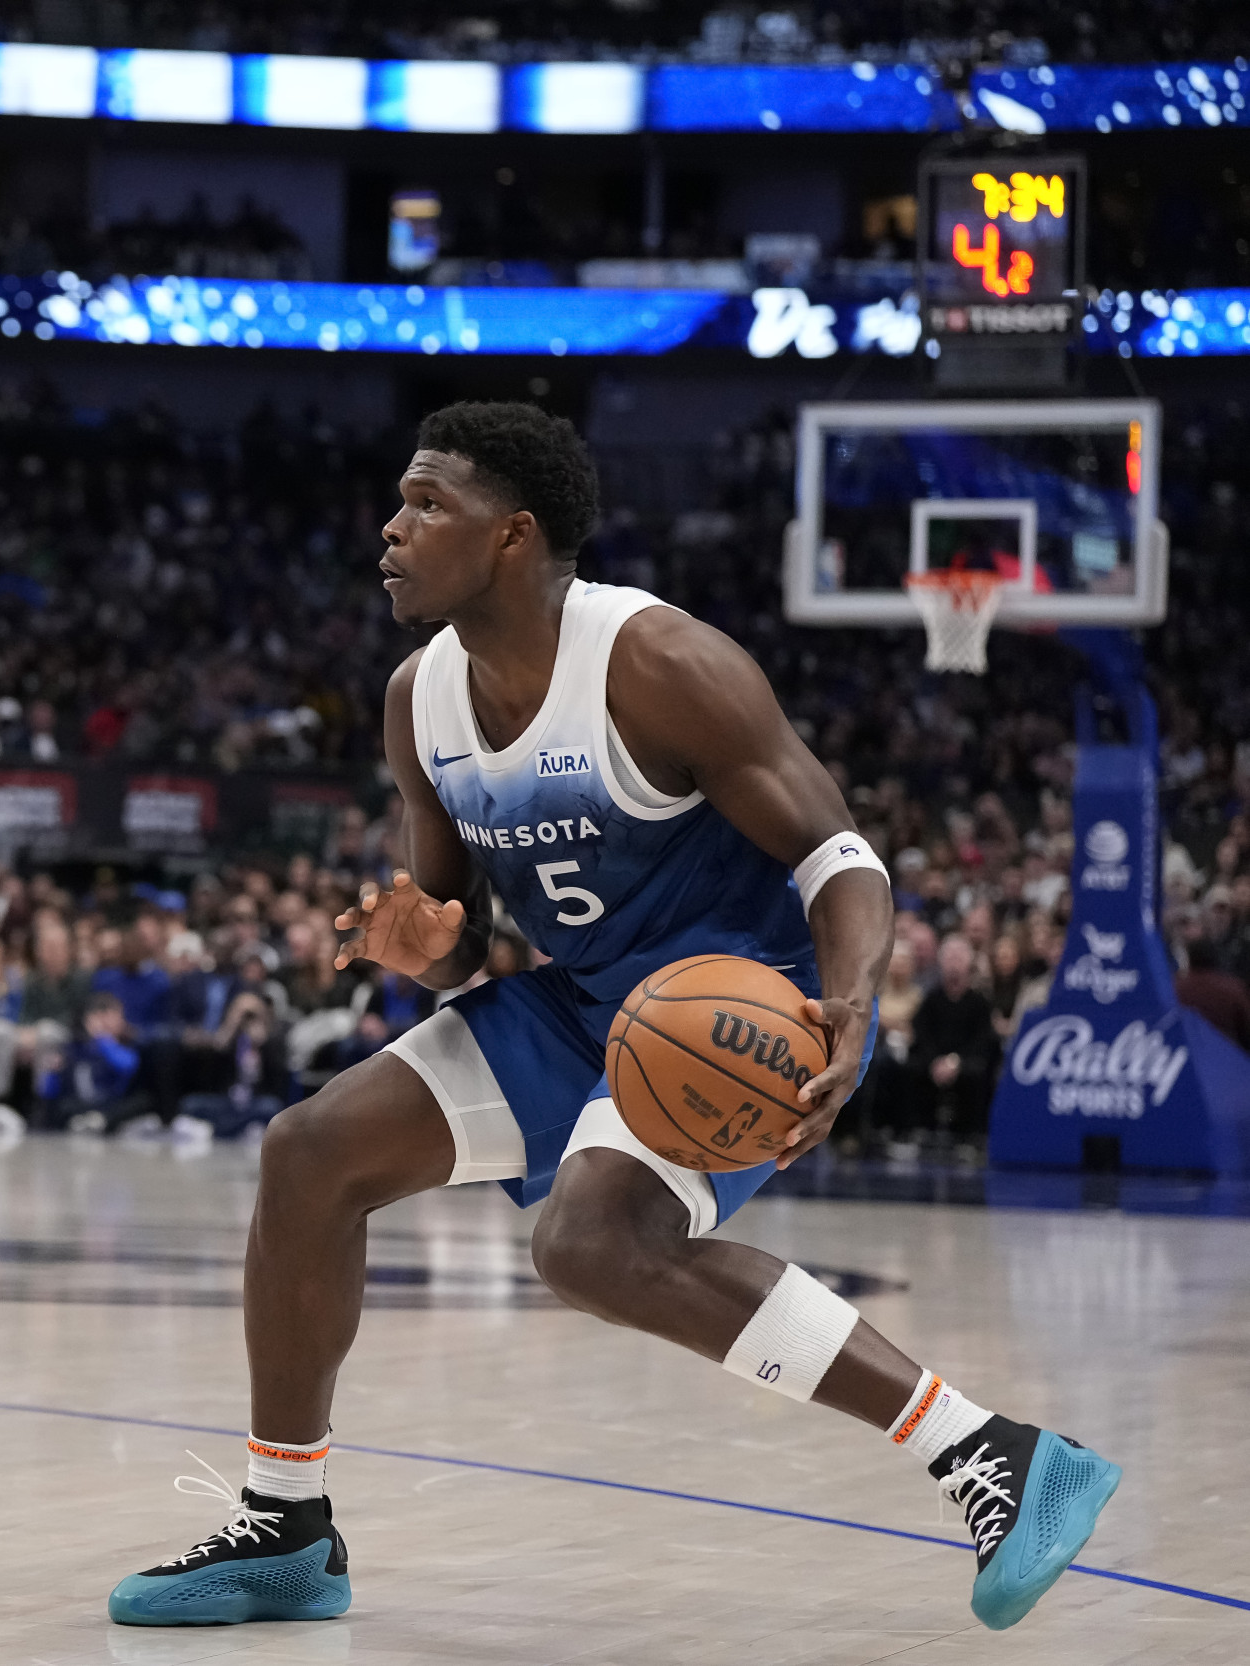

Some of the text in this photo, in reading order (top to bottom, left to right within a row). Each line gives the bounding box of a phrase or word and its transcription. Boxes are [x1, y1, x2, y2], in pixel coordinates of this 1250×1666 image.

[971, 171, 1065, 223] 7:34
[534, 859, 605, 926] 5
[710, 1009, 820, 1090] Wilso
[1011, 1014, 1188, 1106] Bally
[1049, 1080, 1145, 1120] SPORTS
[756, 1359, 781, 1384] 5
[919, 1381, 940, 1411] NBA
[281, 1452, 312, 1461] NBA
